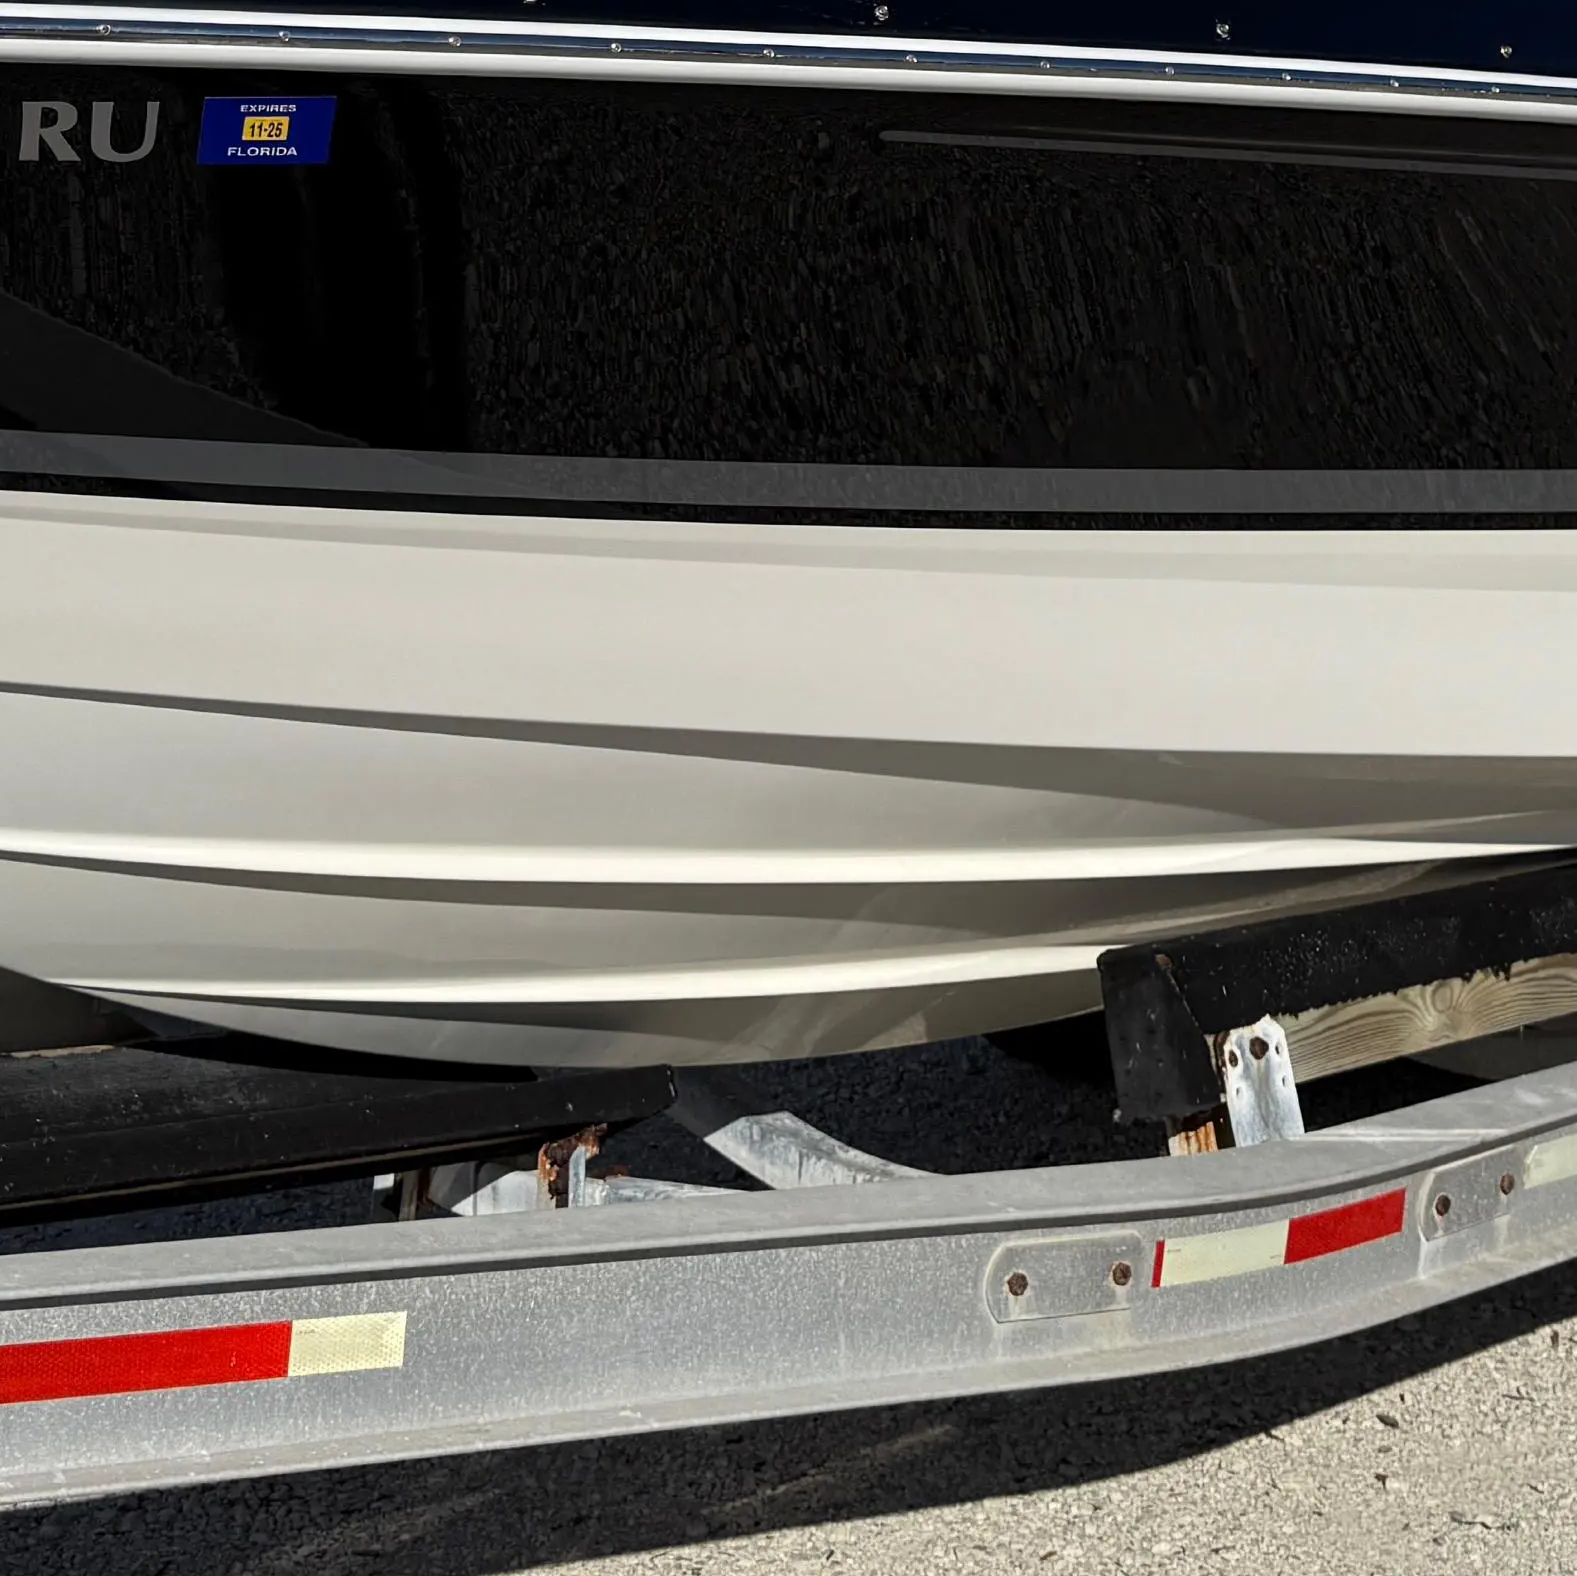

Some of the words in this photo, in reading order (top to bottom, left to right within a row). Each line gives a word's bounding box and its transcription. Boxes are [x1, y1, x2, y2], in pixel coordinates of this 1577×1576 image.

[18, 99, 161, 163] RU
[249, 122, 284, 138] 11-25
[227, 146, 298, 156] FLORIDA
